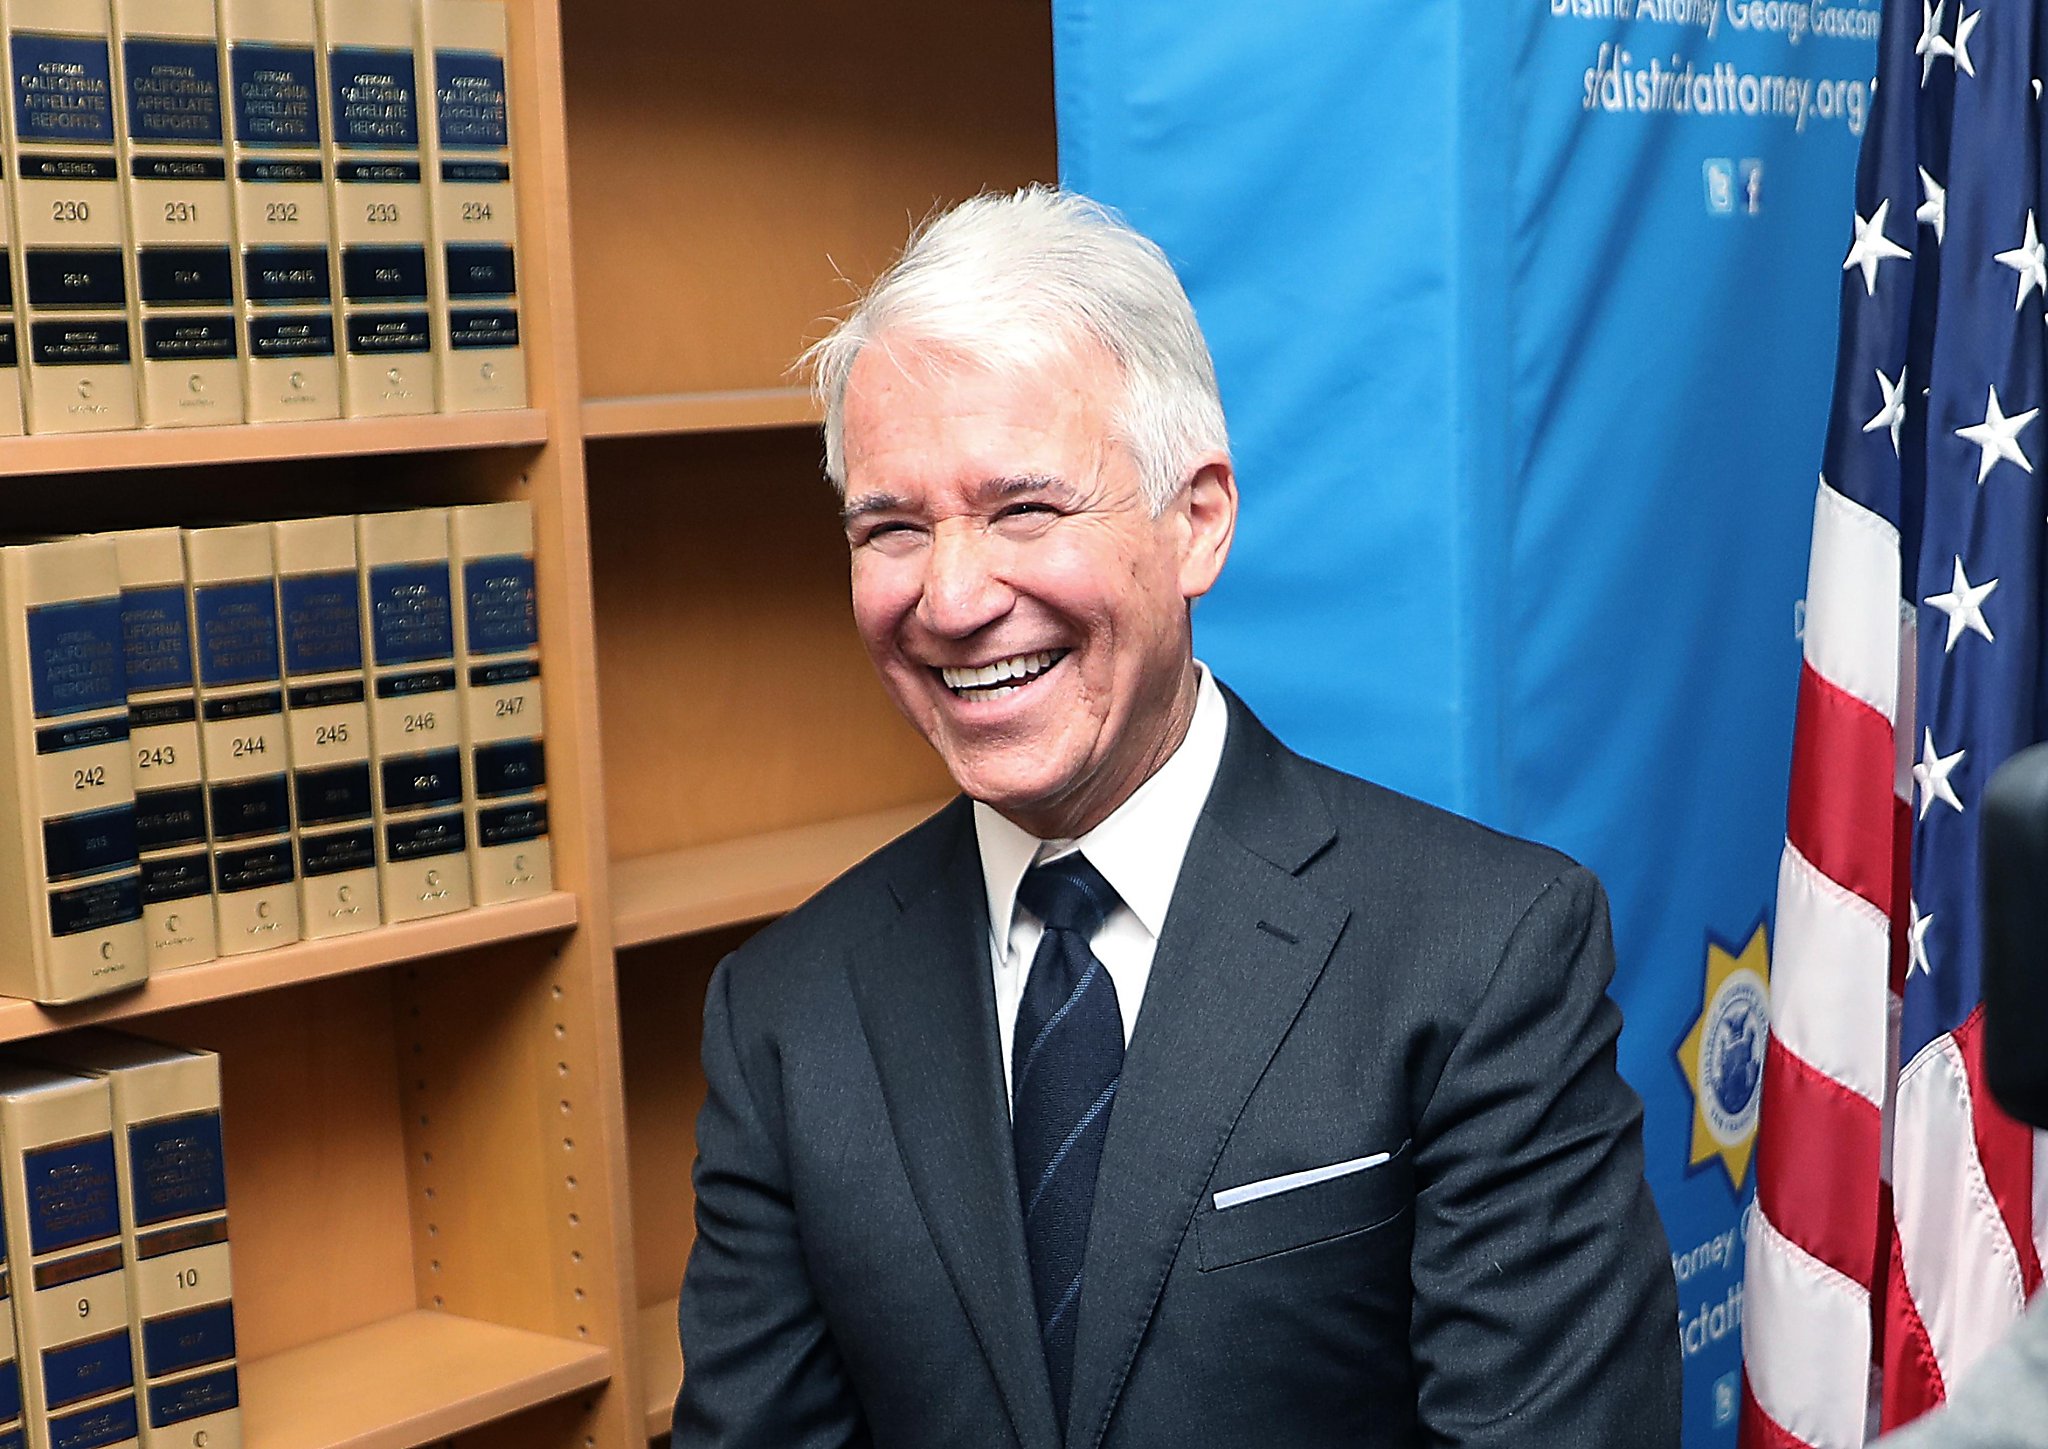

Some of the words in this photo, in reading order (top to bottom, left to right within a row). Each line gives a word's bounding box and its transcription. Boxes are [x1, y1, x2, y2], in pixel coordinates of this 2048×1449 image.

[1726, 0, 1808, 45] George
[38, 62, 84, 74] OFFICIAL
[151, 65, 195, 77] OFFICIAL
[21, 75, 106, 92] CALIFORNIA
[134, 77, 213, 94] CALIFORNIA
[24, 94, 105, 111] APPELLATE
[137, 96, 213, 113] APPELLATE
[31, 112, 101, 128] REPORTS
[144, 115, 210, 129] REPORTS
[53, 201, 89, 221] 230
[165, 203, 196, 221] 231
[266, 203, 298, 221] 232
[367, 204, 397, 222] 233
[462, 202, 492, 221] 234
[496, 697, 524, 716] 247
[404, 712, 435, 733] 246
[316, 724, 348, 745] 245
[232, 736, 265, 757] 244
[138, 746, 175, 768] 243
[74, 766, 105, 789] 242
[175, 1268, 198, 1289] 10
[78, 1298, 90, 1318] 9
